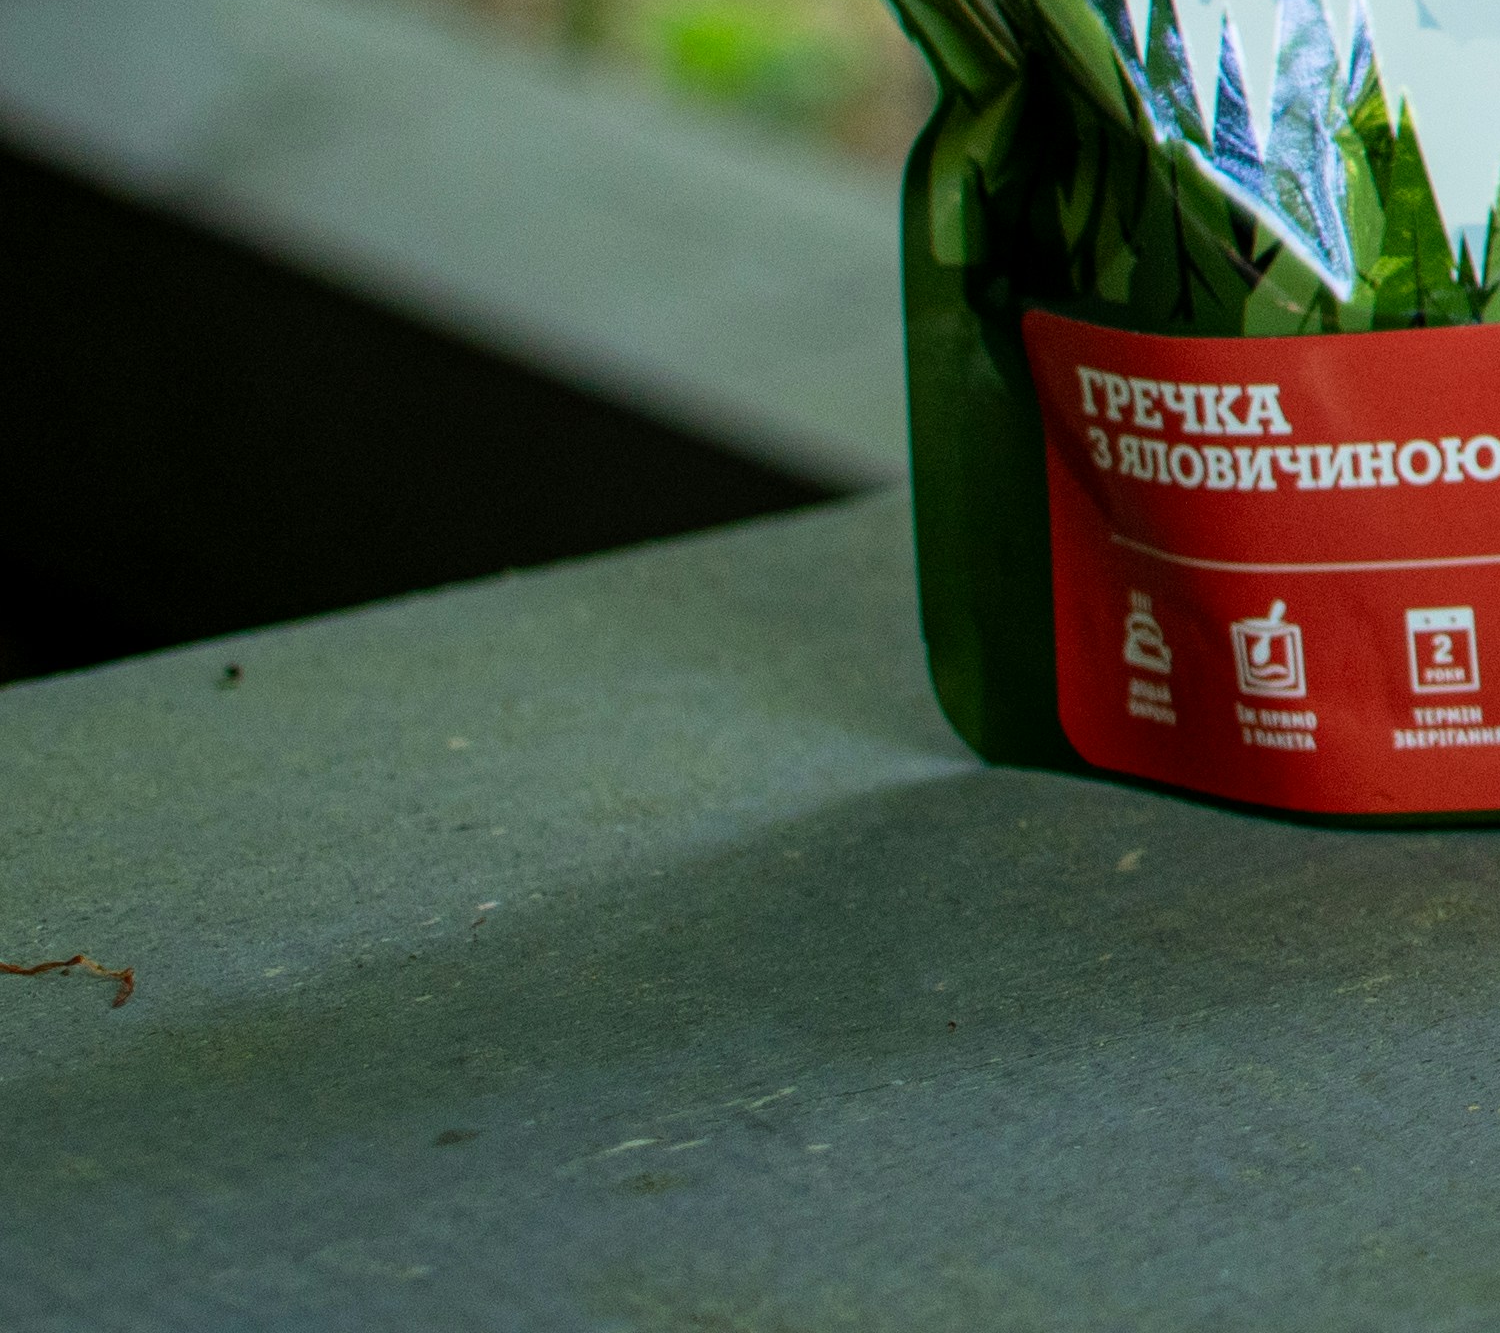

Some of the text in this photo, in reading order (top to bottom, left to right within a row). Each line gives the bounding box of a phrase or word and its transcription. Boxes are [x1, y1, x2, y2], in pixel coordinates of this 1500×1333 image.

[1076, 365, 1293, 435] ГРЕЧКА
[1087, 426, 1112, 470] З
[1431, 633, 1454, 665] 2
[1424, 667, 1466, 683] РОКИ
[1412, 705, 1484, 727] ТЕРМІН
